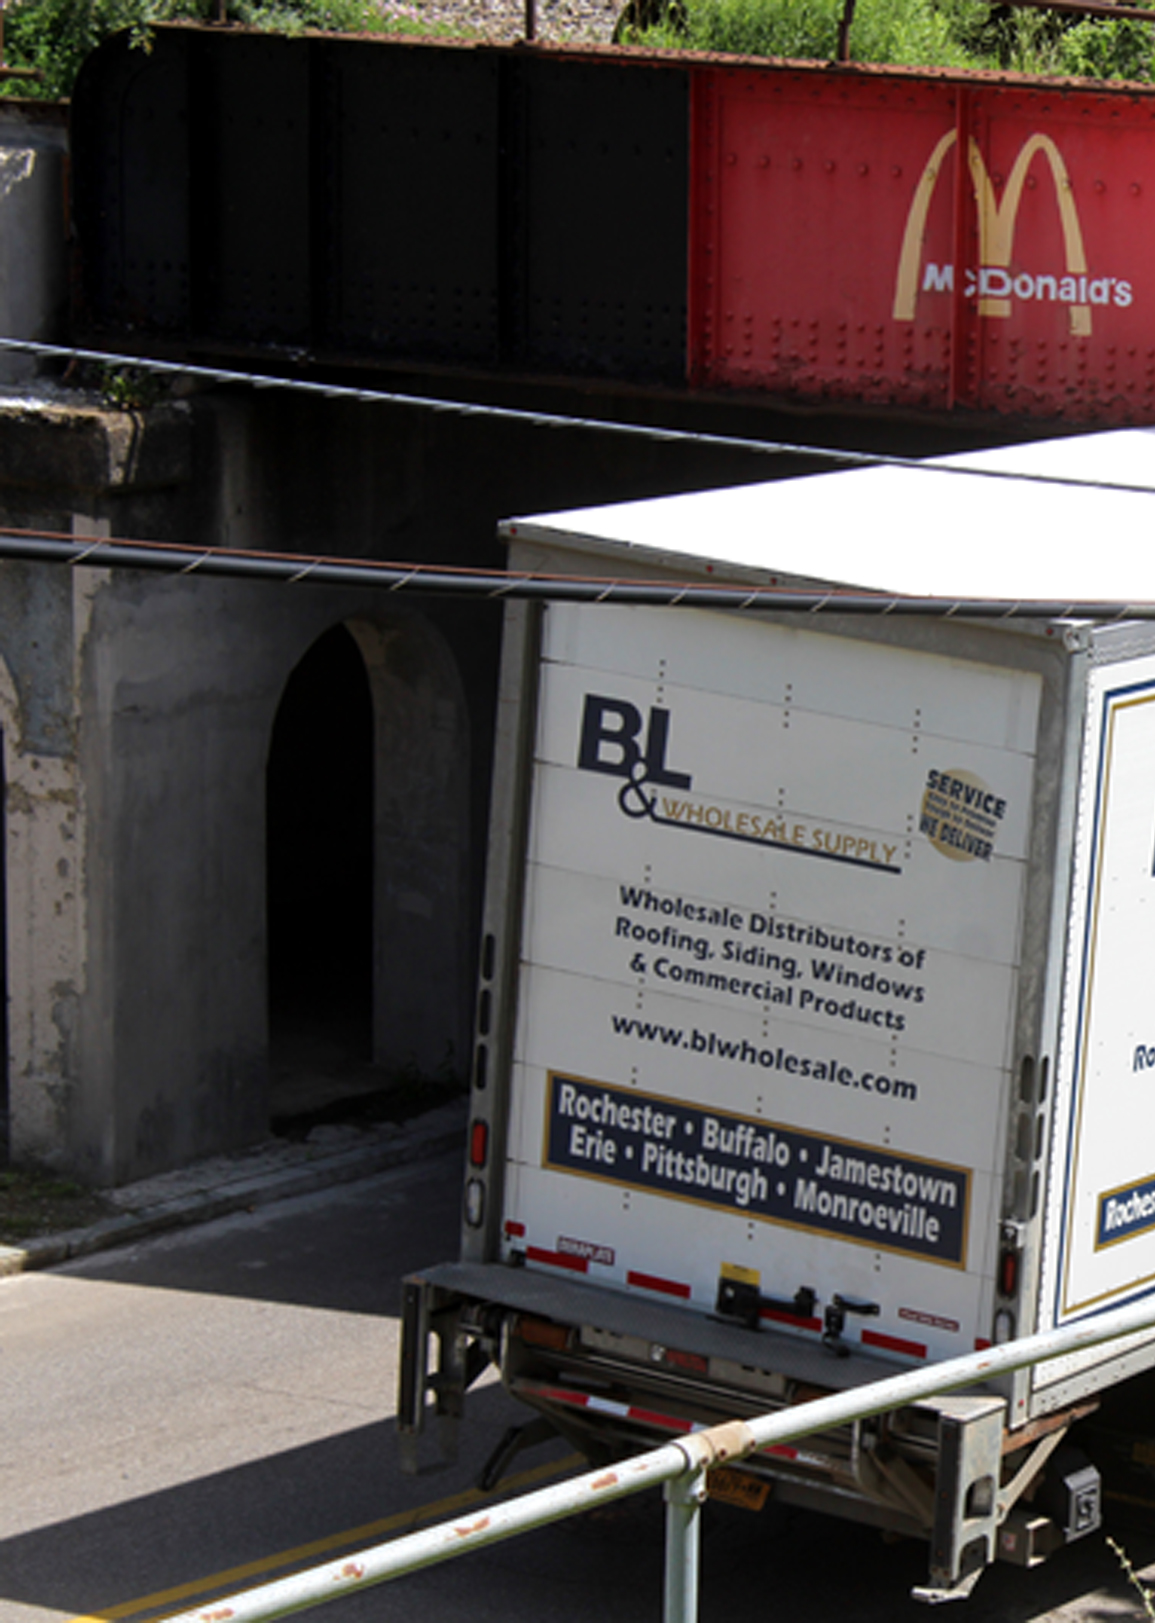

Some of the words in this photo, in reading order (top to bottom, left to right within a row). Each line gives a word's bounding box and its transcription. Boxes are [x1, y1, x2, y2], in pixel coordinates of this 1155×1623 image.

[662, 798, 804, 846] WHOLESALE
[811, 829, 898, 865] SUPPLY
[926, 769, 1006, 821] SERVICE
[940, 821, 993, 862] DELIVER
[615, 917, 716, 960] Roofing,
[721, 940, 803, 979] Siding,
[811, 959, 925, 1003] Windows
[620, 885, 743, 930] Wholesale
[749, 913, 892, 963] Distributors
[899, 949, 926, 969] of
[630, 953, 647, 973] &
[653, 957, 792, 1006] Commercial
[800, 989, 906, 1031] Products
[612, 1014, 917, 1100] www.blwholesale.com
[559, 1084, 676, 1140] Rochester
[703, 1119, 790, 1167] Buffalo
[815, 1146, 956, 1207] Jamestown
[570, 1123, 616, 1163] Erie
[642, 1143, 767, 1205] Pittsburgh
[795, 1178, 940, 1243] Monroeville
